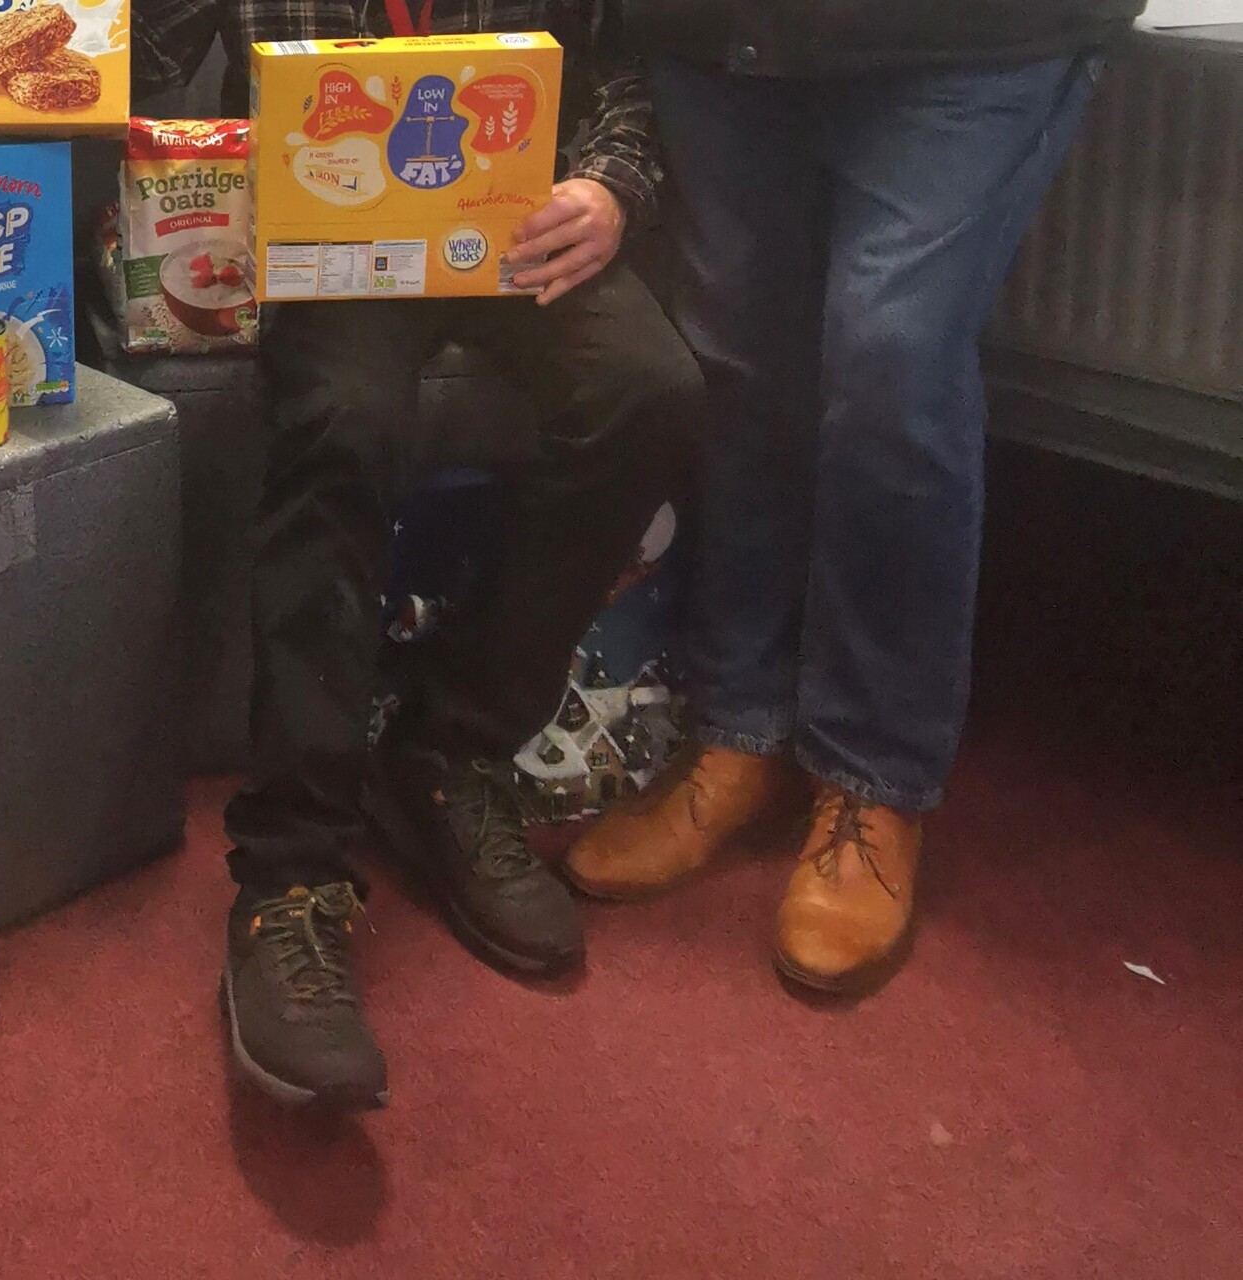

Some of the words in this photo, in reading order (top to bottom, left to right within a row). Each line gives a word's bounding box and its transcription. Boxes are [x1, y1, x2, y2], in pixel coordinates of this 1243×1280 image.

[324, 81, 352, 94] HIGH
[417, 87, 446, 101] LOW
[324, 93, 339, 106] IN
[423, 101, 438, 113] IN
[399, 161, 452, 186] FAT
[136, 167, 246, 202] Porridge
[159, 193, 216, 214] oats
[169, 215, 214, 230] ORIGINAL
[448, 238, 483, 253] Wheat
[451, 250, 481, 263] Bisks
